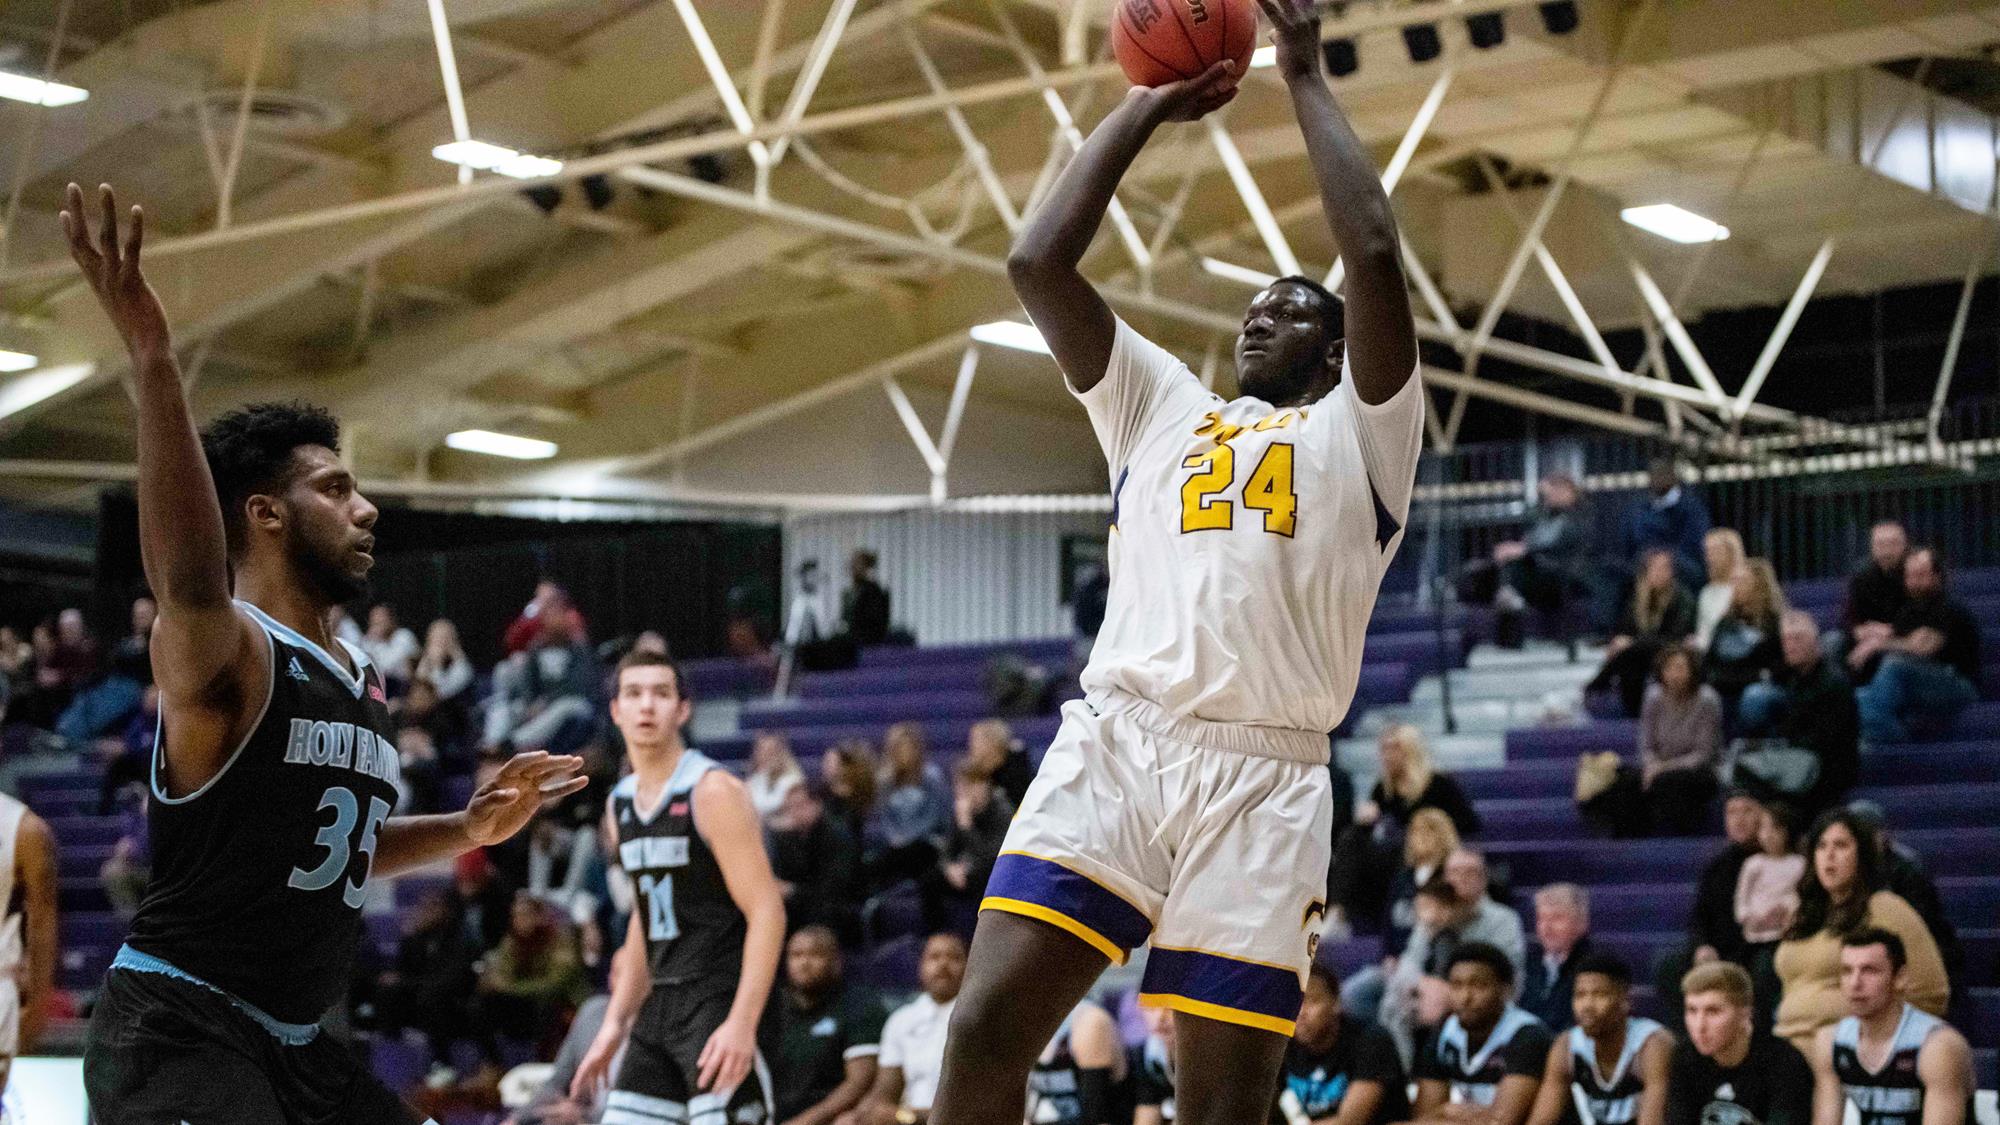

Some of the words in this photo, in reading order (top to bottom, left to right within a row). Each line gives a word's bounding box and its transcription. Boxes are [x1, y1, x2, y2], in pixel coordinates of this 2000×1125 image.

[1181, 441, 1298, 538] 24
[284, 718, 354, 768] HOLY
[287, 786, 391, 909] 35
